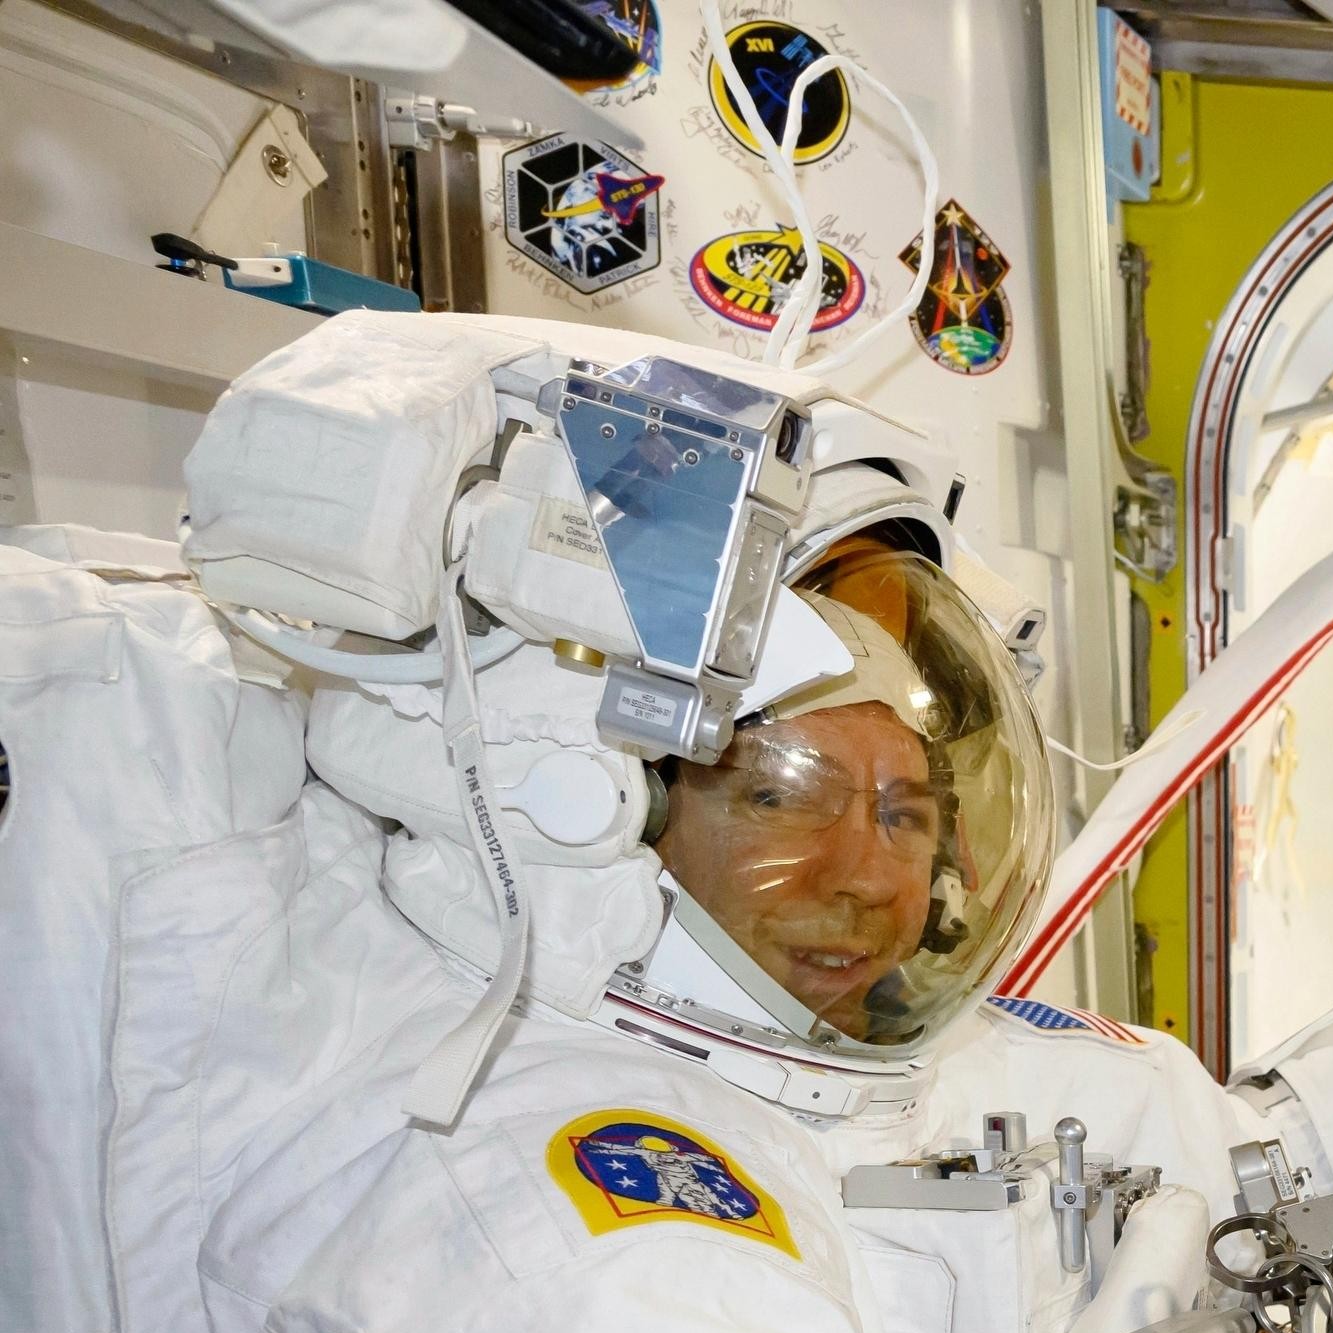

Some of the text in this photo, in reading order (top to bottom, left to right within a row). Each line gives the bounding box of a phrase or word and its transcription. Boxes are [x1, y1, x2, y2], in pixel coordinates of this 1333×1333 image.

[745, 38, 775, 52] XVI
[529, 136, 565, 158] ZAMKA
[507, 170, 518, 229] ROBINSON
[523, 244, 576, 282] BEHNKEN
[600, 262, 642, 285] PATRICK
[562, 513, 588, 528] HECA
[547, 531, 564, 543] P/N
[465, 764, 481, 794] P/N
